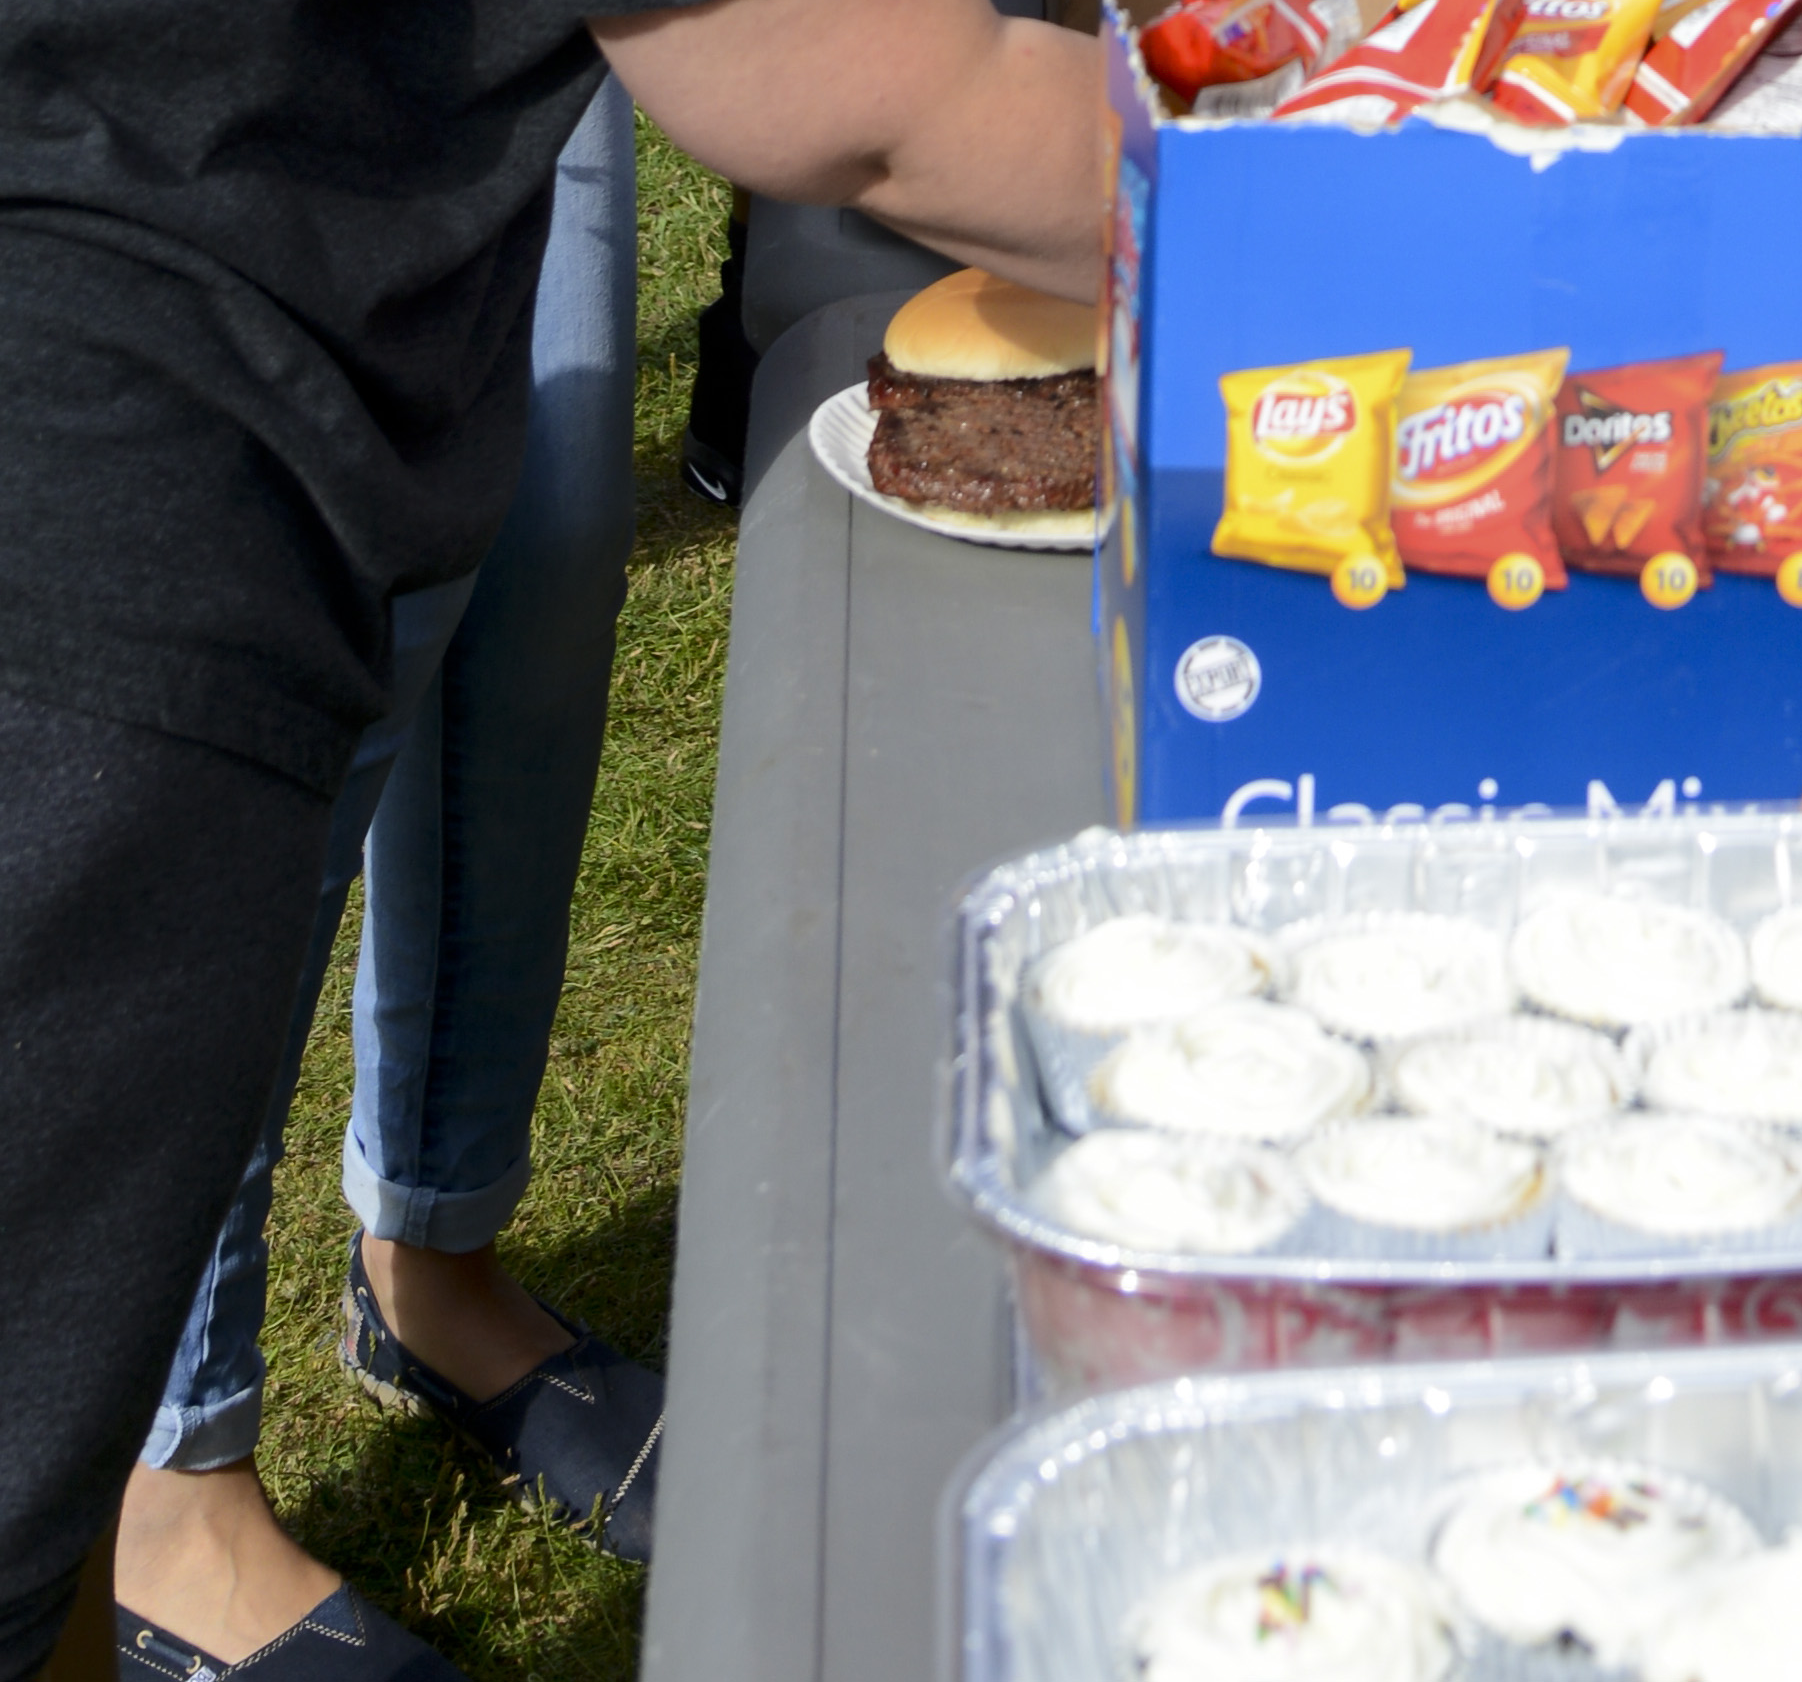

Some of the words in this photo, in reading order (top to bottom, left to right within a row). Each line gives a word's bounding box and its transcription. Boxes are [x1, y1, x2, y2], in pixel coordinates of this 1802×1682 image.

[1396, 393, 1525, 481] Fritos
[1563, 410, 1673, 447] Doritos
[1348, 569, 1378, 592] 10
[1503, 569, 1536, 593] 10
[1655, 568, 1687, 592] 10
